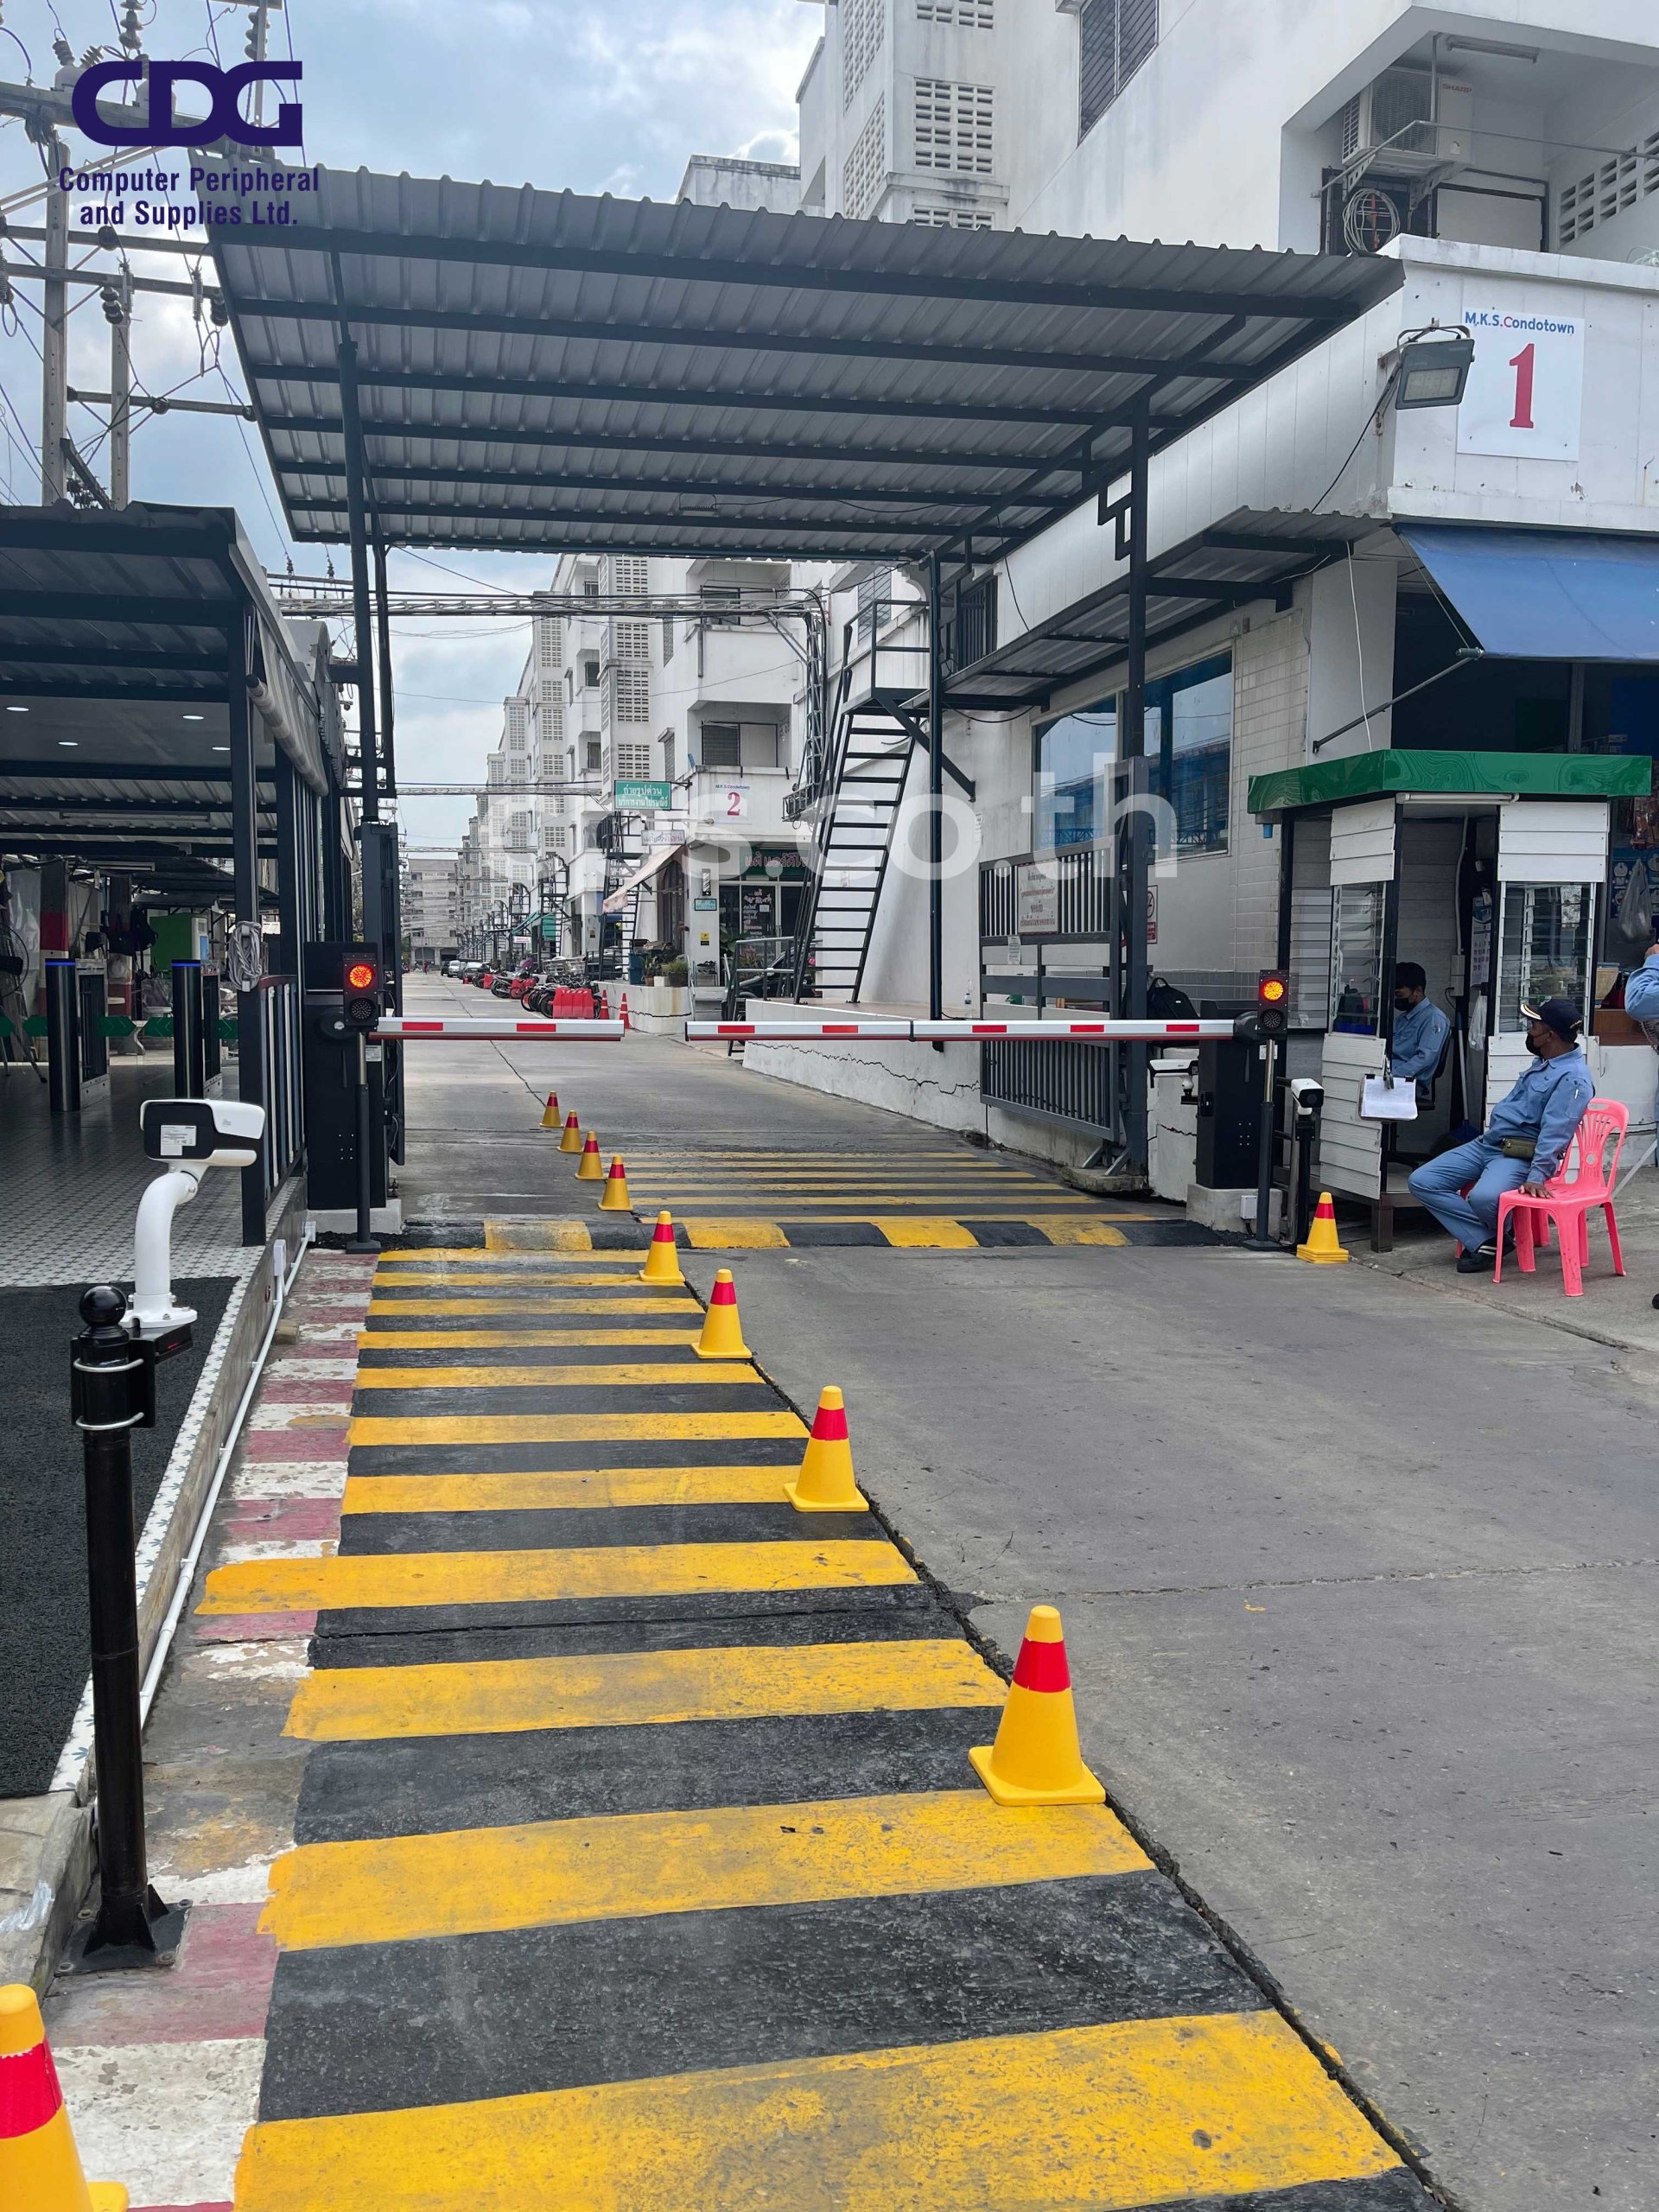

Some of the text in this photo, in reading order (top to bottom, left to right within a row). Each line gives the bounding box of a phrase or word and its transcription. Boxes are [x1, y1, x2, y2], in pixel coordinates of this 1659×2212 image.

[1509, 342, 1535, 429] 1
[623, 783, 663, 797] ถ่ายรูปด่วน
[727, 791, 741, 817] 2
